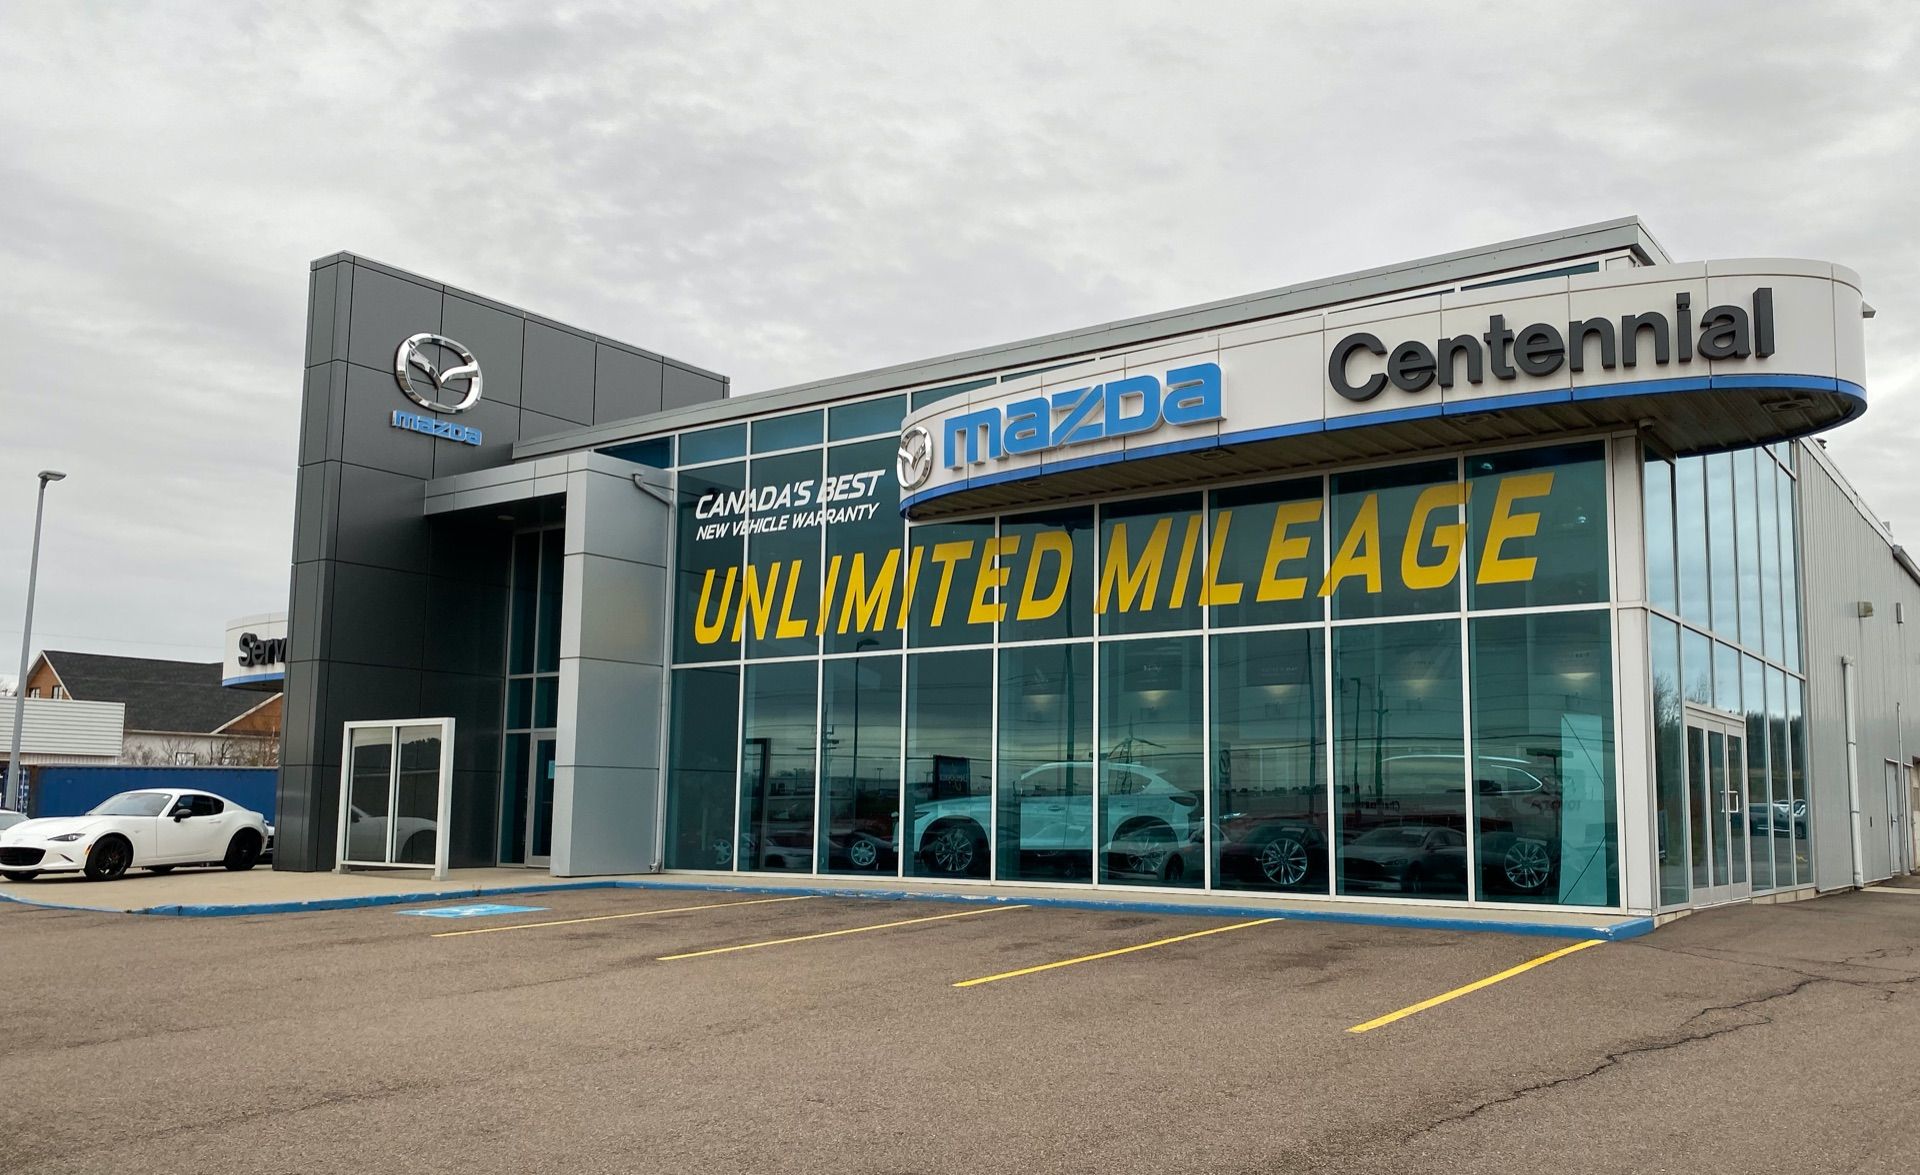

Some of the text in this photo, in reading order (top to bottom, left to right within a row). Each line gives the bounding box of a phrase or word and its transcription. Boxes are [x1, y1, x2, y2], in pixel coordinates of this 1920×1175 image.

[1328, 287, 1775, 402] Centennial
[392, 409, 482, 446] mazda
[944, 362, 1226, 470] mazda
[695, 469, 886, 519] CANADA'S BEST
[695, 502, 881, 541] NEW VEHICLE WARRANTY
[694, 472, 1556, 645] UNLIMITED MILEAGE
